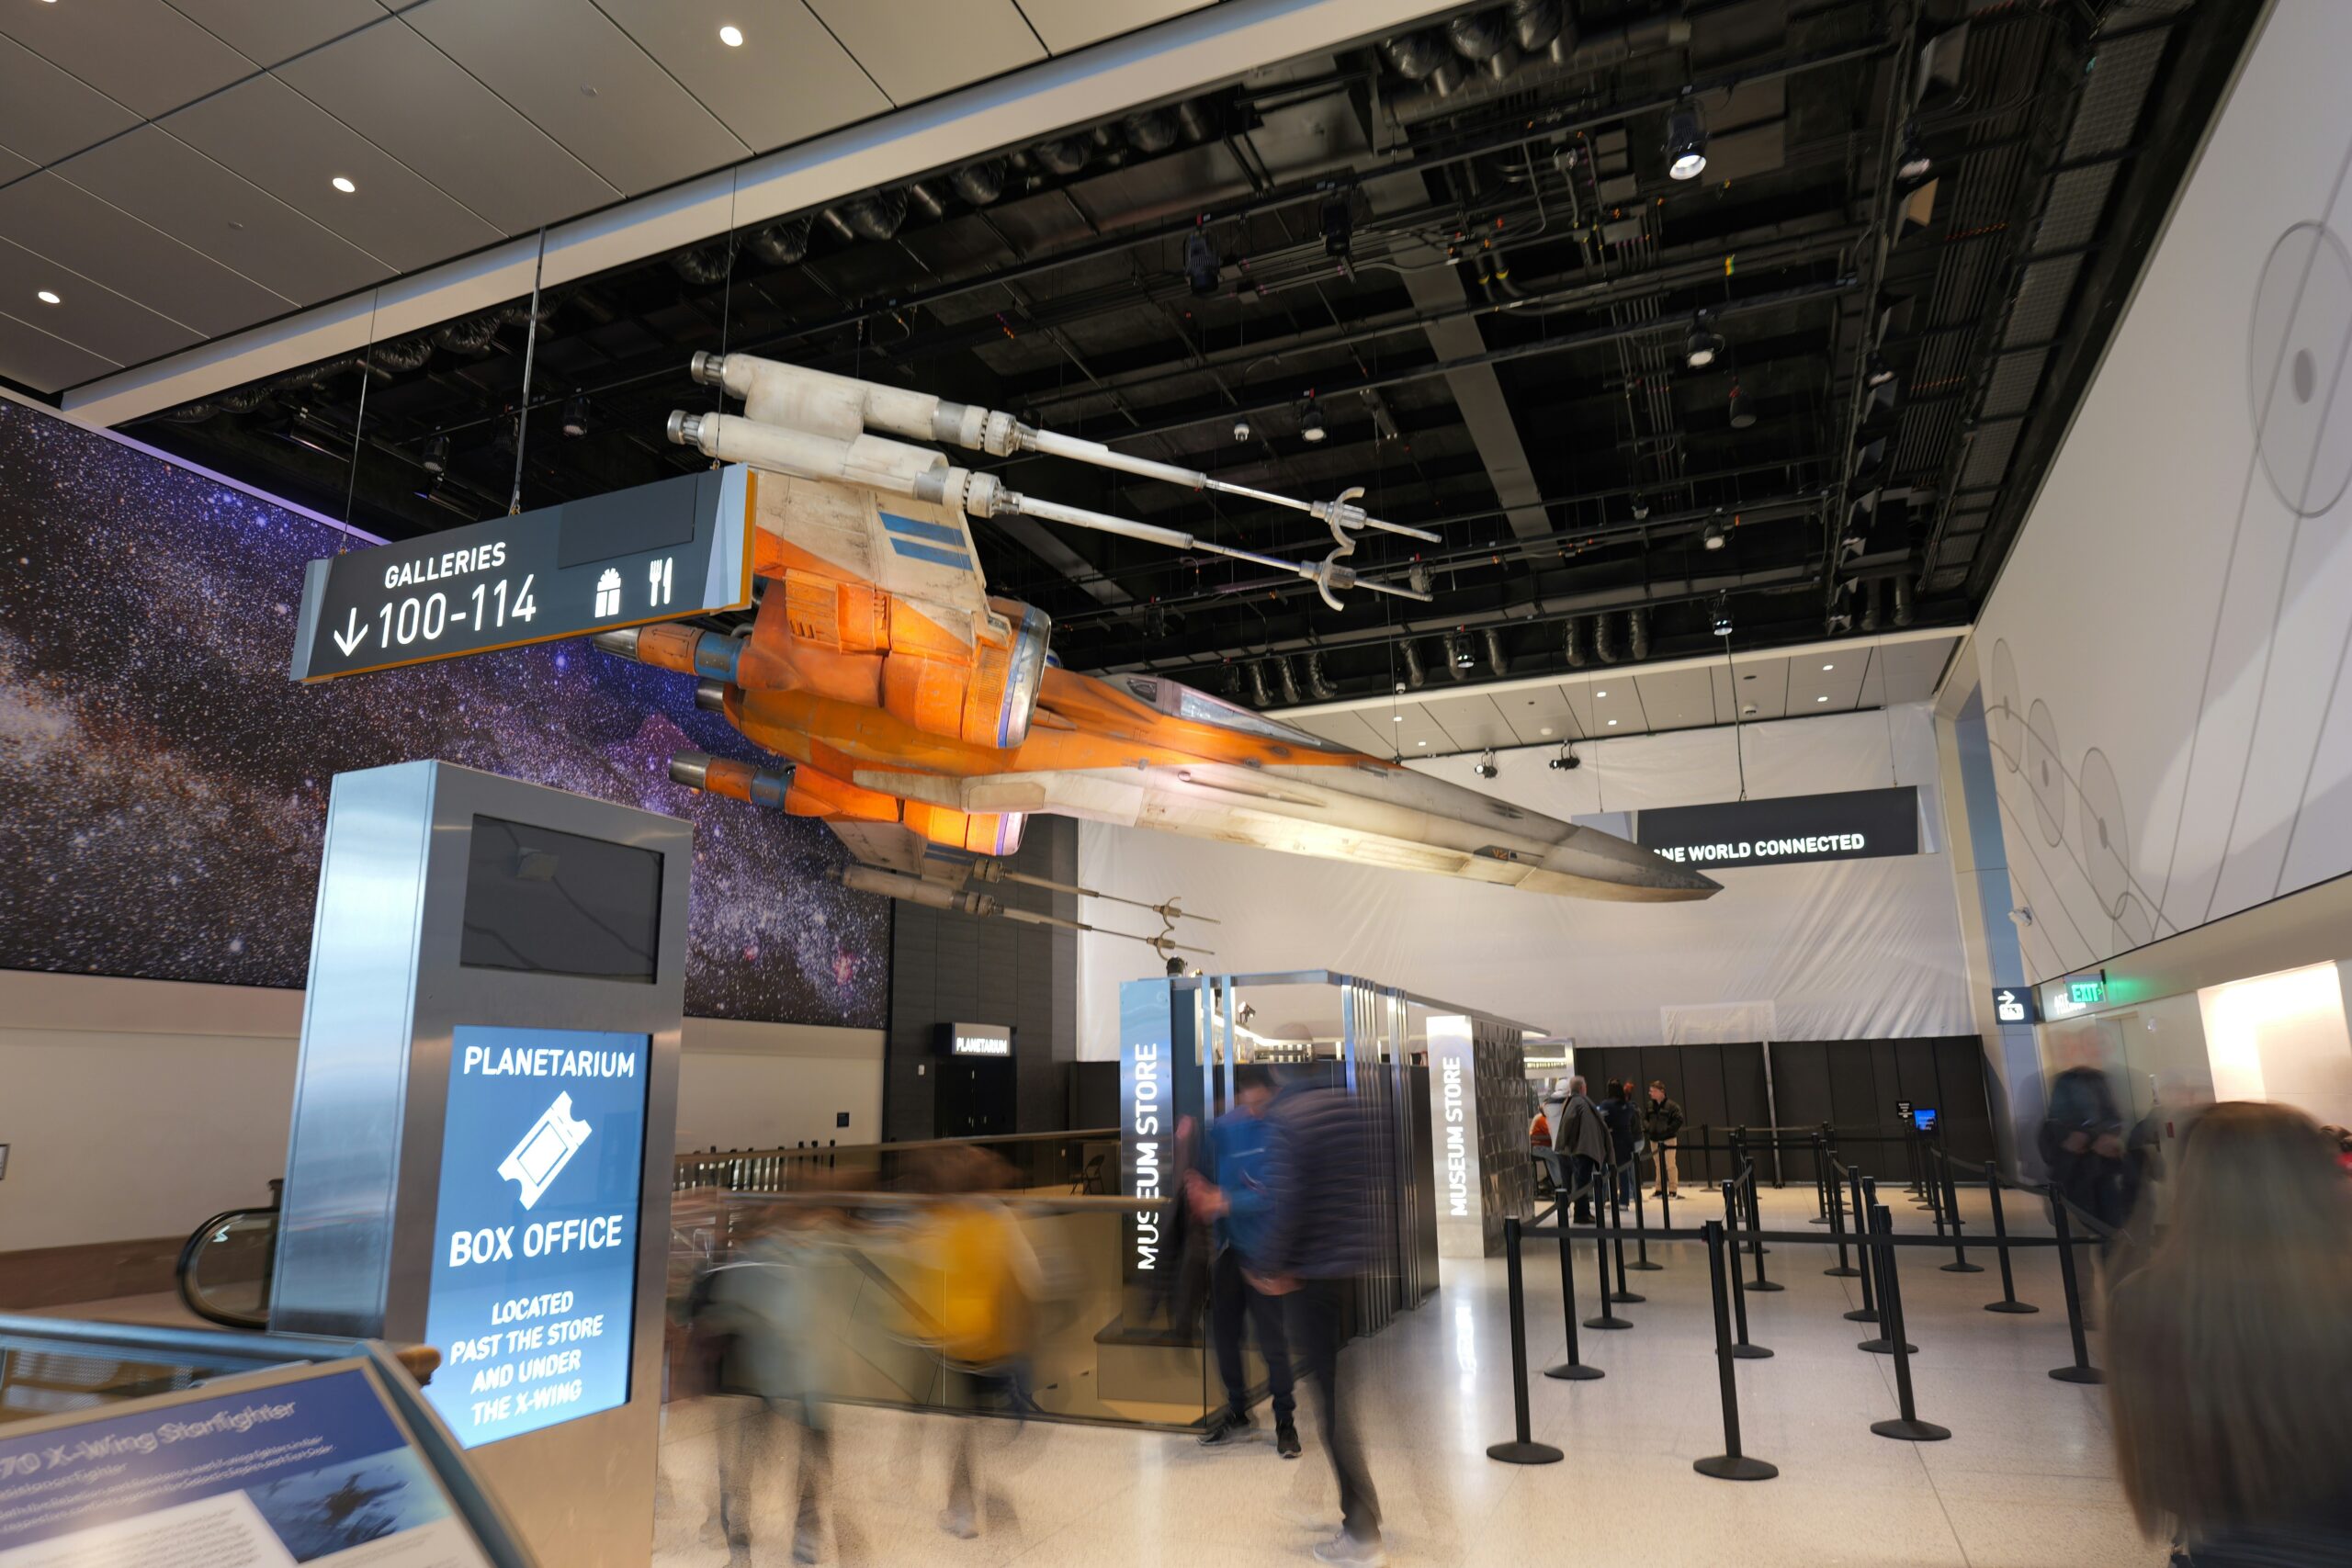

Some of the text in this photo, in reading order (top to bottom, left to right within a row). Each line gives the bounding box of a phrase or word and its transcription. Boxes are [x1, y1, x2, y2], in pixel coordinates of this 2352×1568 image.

[384, 542, 506, 589] GALLERIES
[379, 574, 537, 649] 100-114
[1654, 833, 1865, 863] NE WORLD CONNECTED
[2071, 983, 2098, 1002] EXIT
[463, 1045, 636, 1077] PLANETARIUM
[956, 1036, 1008, 1054] PLANETARIUM
[1136, 1043, 1159, 1269] MUSEUM STORE
[1442, 1057, 1468, 1216] MUSEUM STORE
[449, 1214, 623, 1268] BOX OFFICE
[491, 1291, 574, 1325] LOCATED
[449, 1314, 605, 1366] PAST THE STORE
[470, 1348, 582, 1394] AND UNDER
[470, 1379, 582, 1426] THE X-WING
[42, 1433, 158, 1470] X-Wing
[157, 1402, 297, 1444] Starfighter
